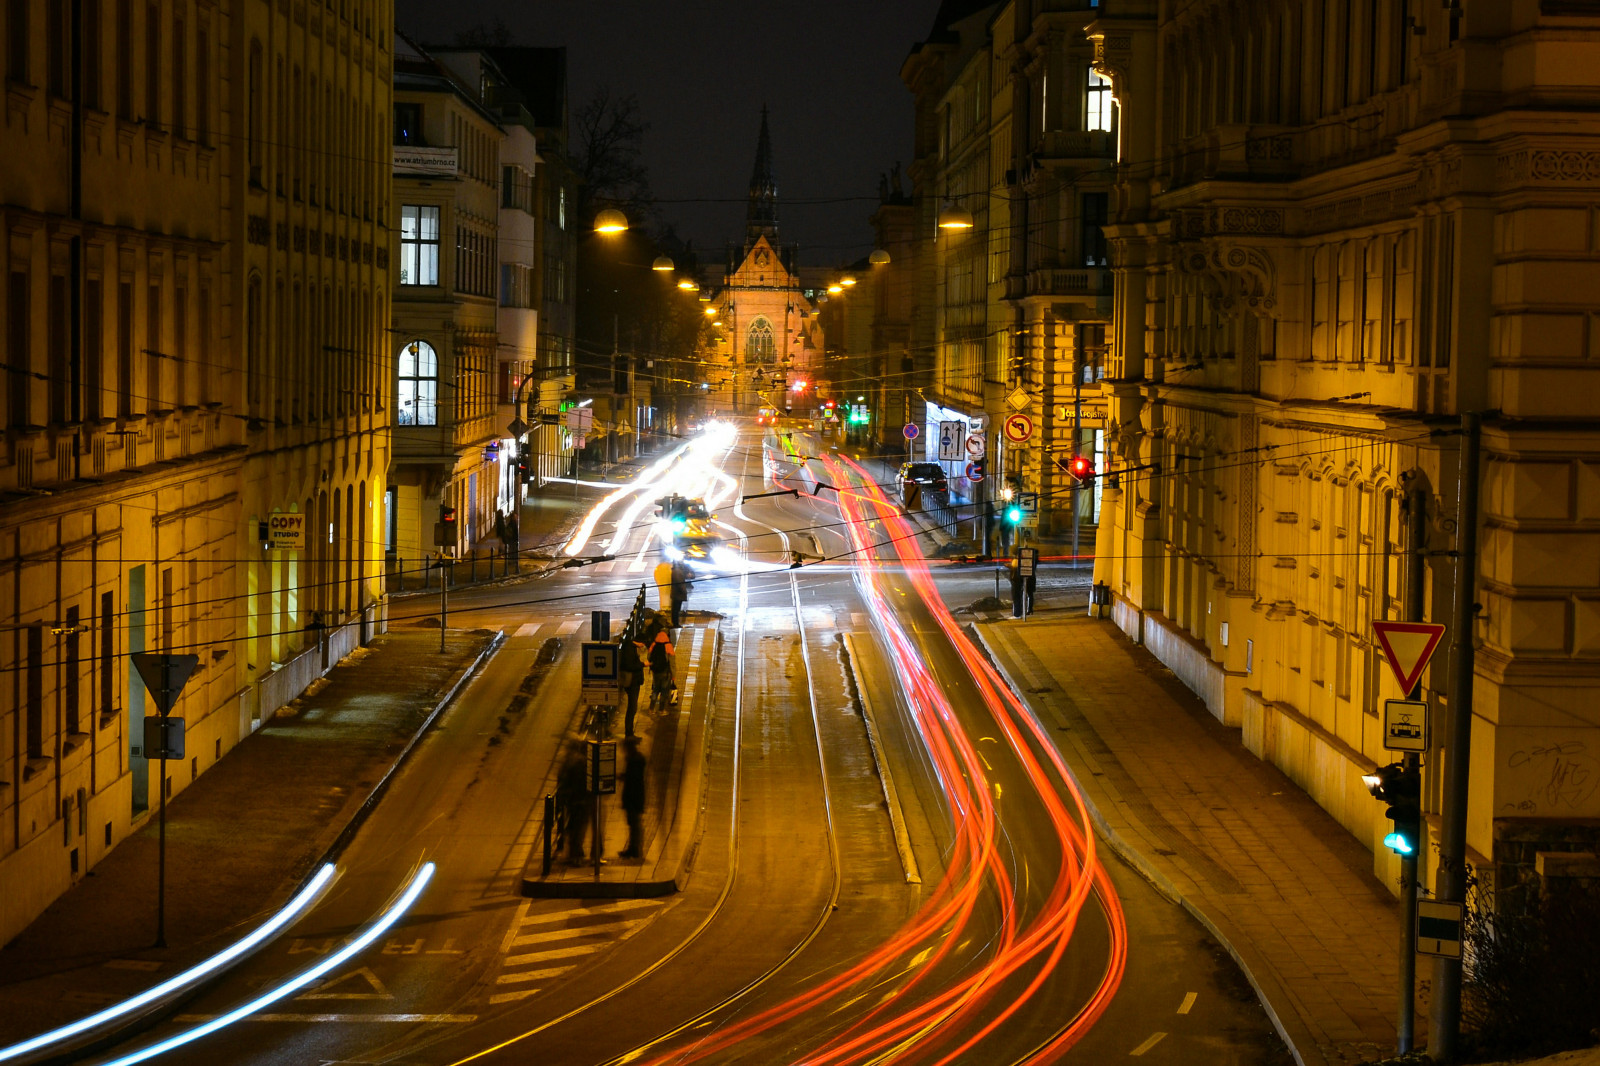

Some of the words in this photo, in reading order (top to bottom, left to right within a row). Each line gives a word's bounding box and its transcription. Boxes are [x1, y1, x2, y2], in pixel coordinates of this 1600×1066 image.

[394, 157, 455, 166] www.atriumbrno.cz
[271, 517, 302, 529] COPY
[287, 938, 464, 955] TRM
